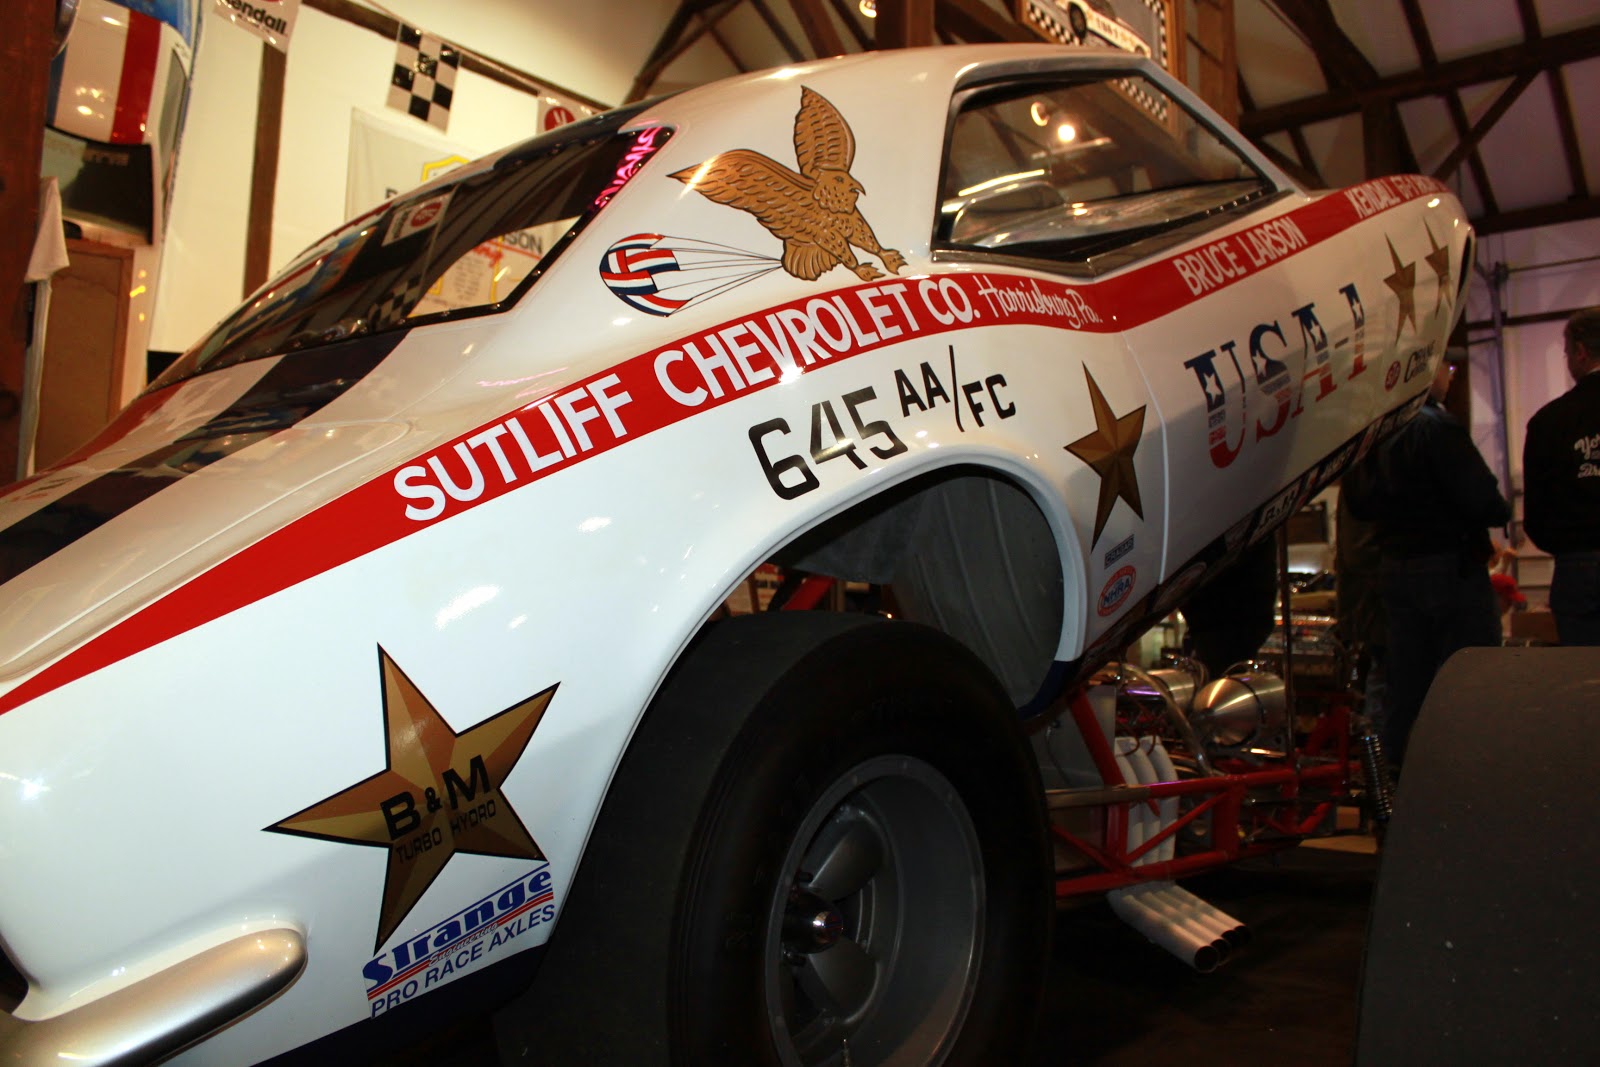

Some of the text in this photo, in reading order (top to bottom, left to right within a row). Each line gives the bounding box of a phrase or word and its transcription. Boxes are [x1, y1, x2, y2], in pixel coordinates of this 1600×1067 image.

[223, 0, 287, 35] endall
[1172, 216, 1308, 297] BRUCE LARSON
[393, 373, 633, 521] SUTLIFF
[653, 283, 920, 407] CHEVROLET
[918, 278, 981, 325] CO.
[1065, 288, 1103, 325] Pa.
[748, 345, 1016, 500] 645 AA/FC
[1183, 282, 1368, 469] USA-1
[1103, 577, 1131, 606] NHRA
[397, 799, 496, 863] TURBO HYDRO
[362, 870, 552, 990] Strange
[371, 904, 555, 1018] PRO RACE AXLES
